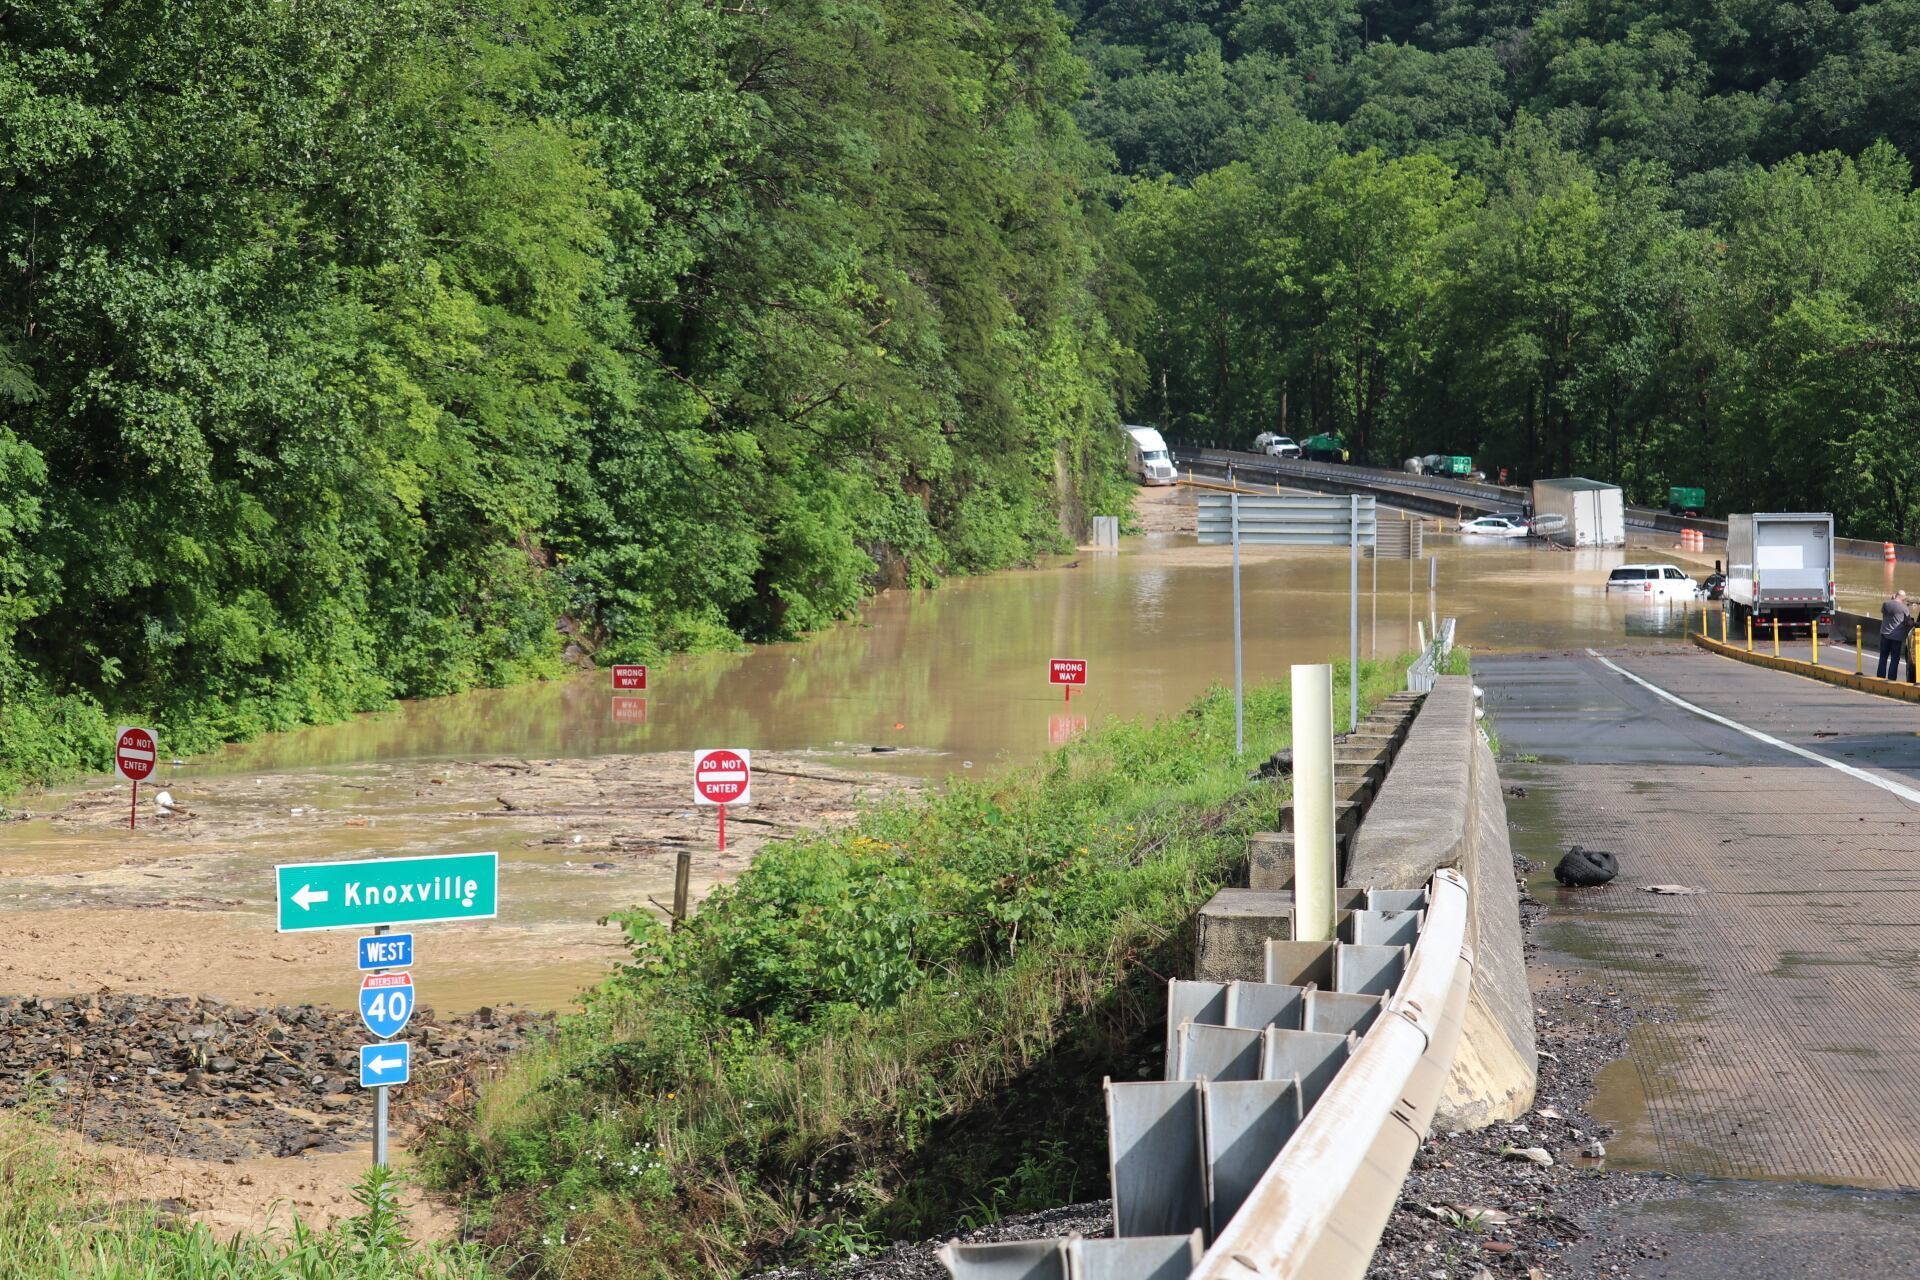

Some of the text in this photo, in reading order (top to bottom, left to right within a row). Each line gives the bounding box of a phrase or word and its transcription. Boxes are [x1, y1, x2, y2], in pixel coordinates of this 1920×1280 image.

[616, 669, 644, 677] WRONG
[1053, 663, 1083, 672] WRONG
[621, 678, 638, 686] WAY
[1059, 672, 1077, 681] WAY
[122, 736, 152, 748] DO NOT
[124, 760, 147, 771] ENTER
[702, 759, 742, 770] DO NOT
[706, 784, 738, 794] ENTER
[344, 876, 478, 907] Knoxville
[366, 941, 406, 963] WEST
[368, 976, 406, 988] INTERSTATE
[367, 991, 407, 1023] 40
